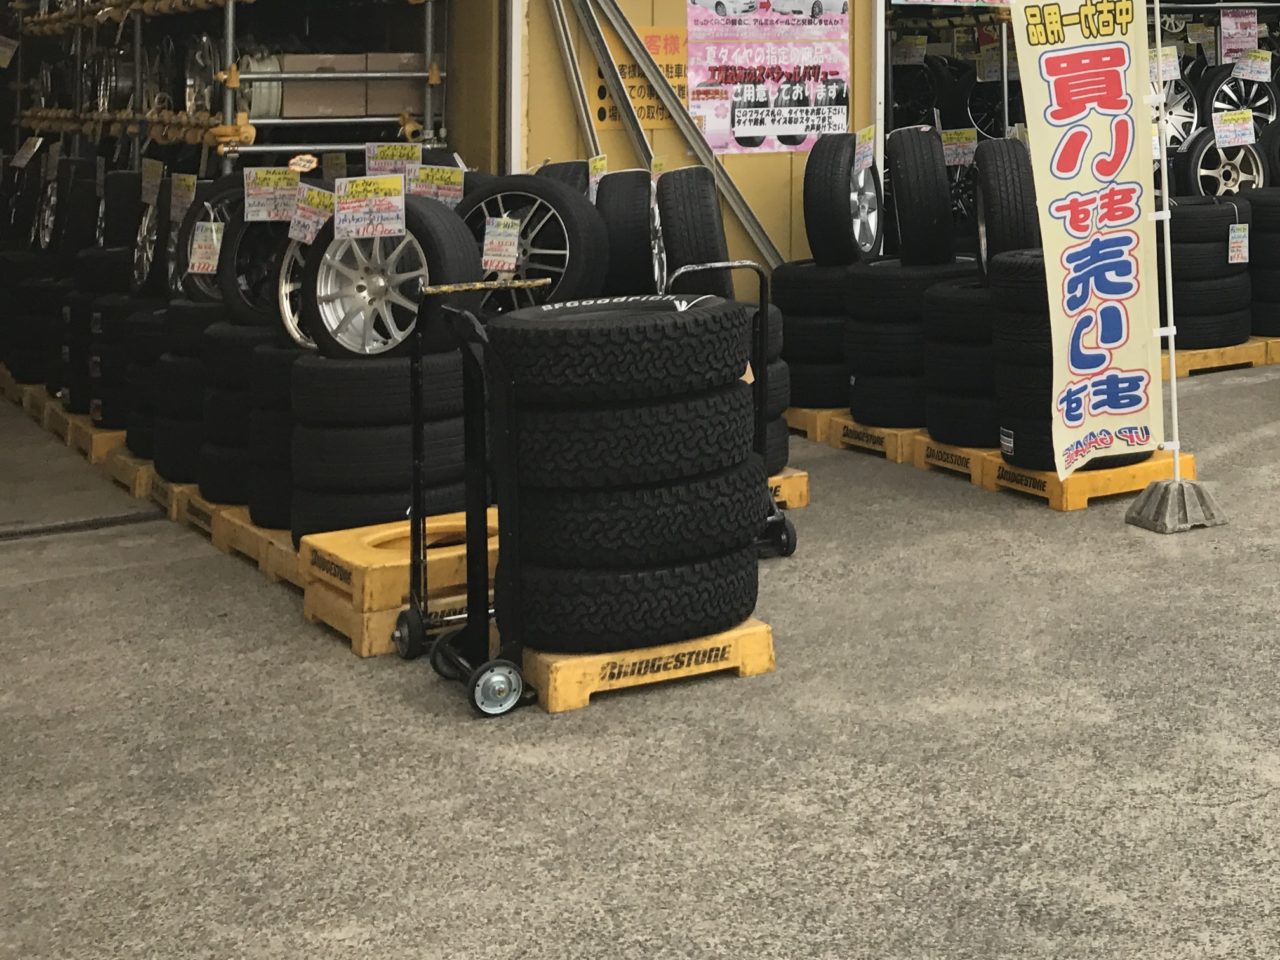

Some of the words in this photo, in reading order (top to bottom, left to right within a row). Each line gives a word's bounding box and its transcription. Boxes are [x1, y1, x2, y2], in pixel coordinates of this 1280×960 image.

[541, 293, 677, 312] BFGoodrich
[926, 446, 971, 468] BRIDGESTONE
[997, 466, 1047, 492] BRIDGESTONE
[600, 644, 732, 681] BRIDGESTONE
